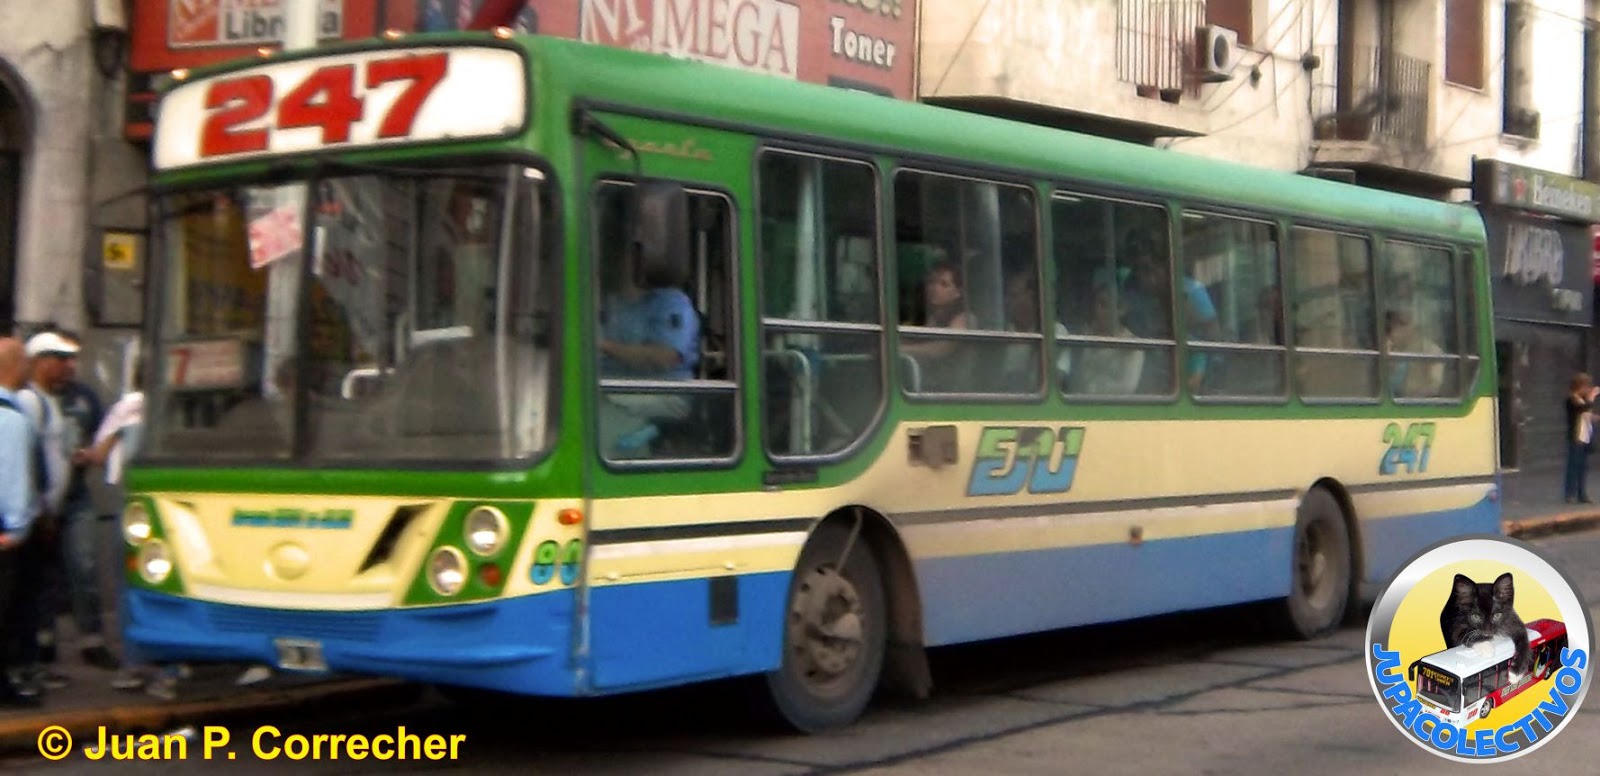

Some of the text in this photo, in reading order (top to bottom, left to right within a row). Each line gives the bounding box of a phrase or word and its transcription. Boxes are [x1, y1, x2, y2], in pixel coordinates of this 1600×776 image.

[659, 0, 791, 74] MEGA
[830, 16, 896, 68] Toner
[200, 52, 450, 158] 247
[1379, 422, 1436, 476] 247
